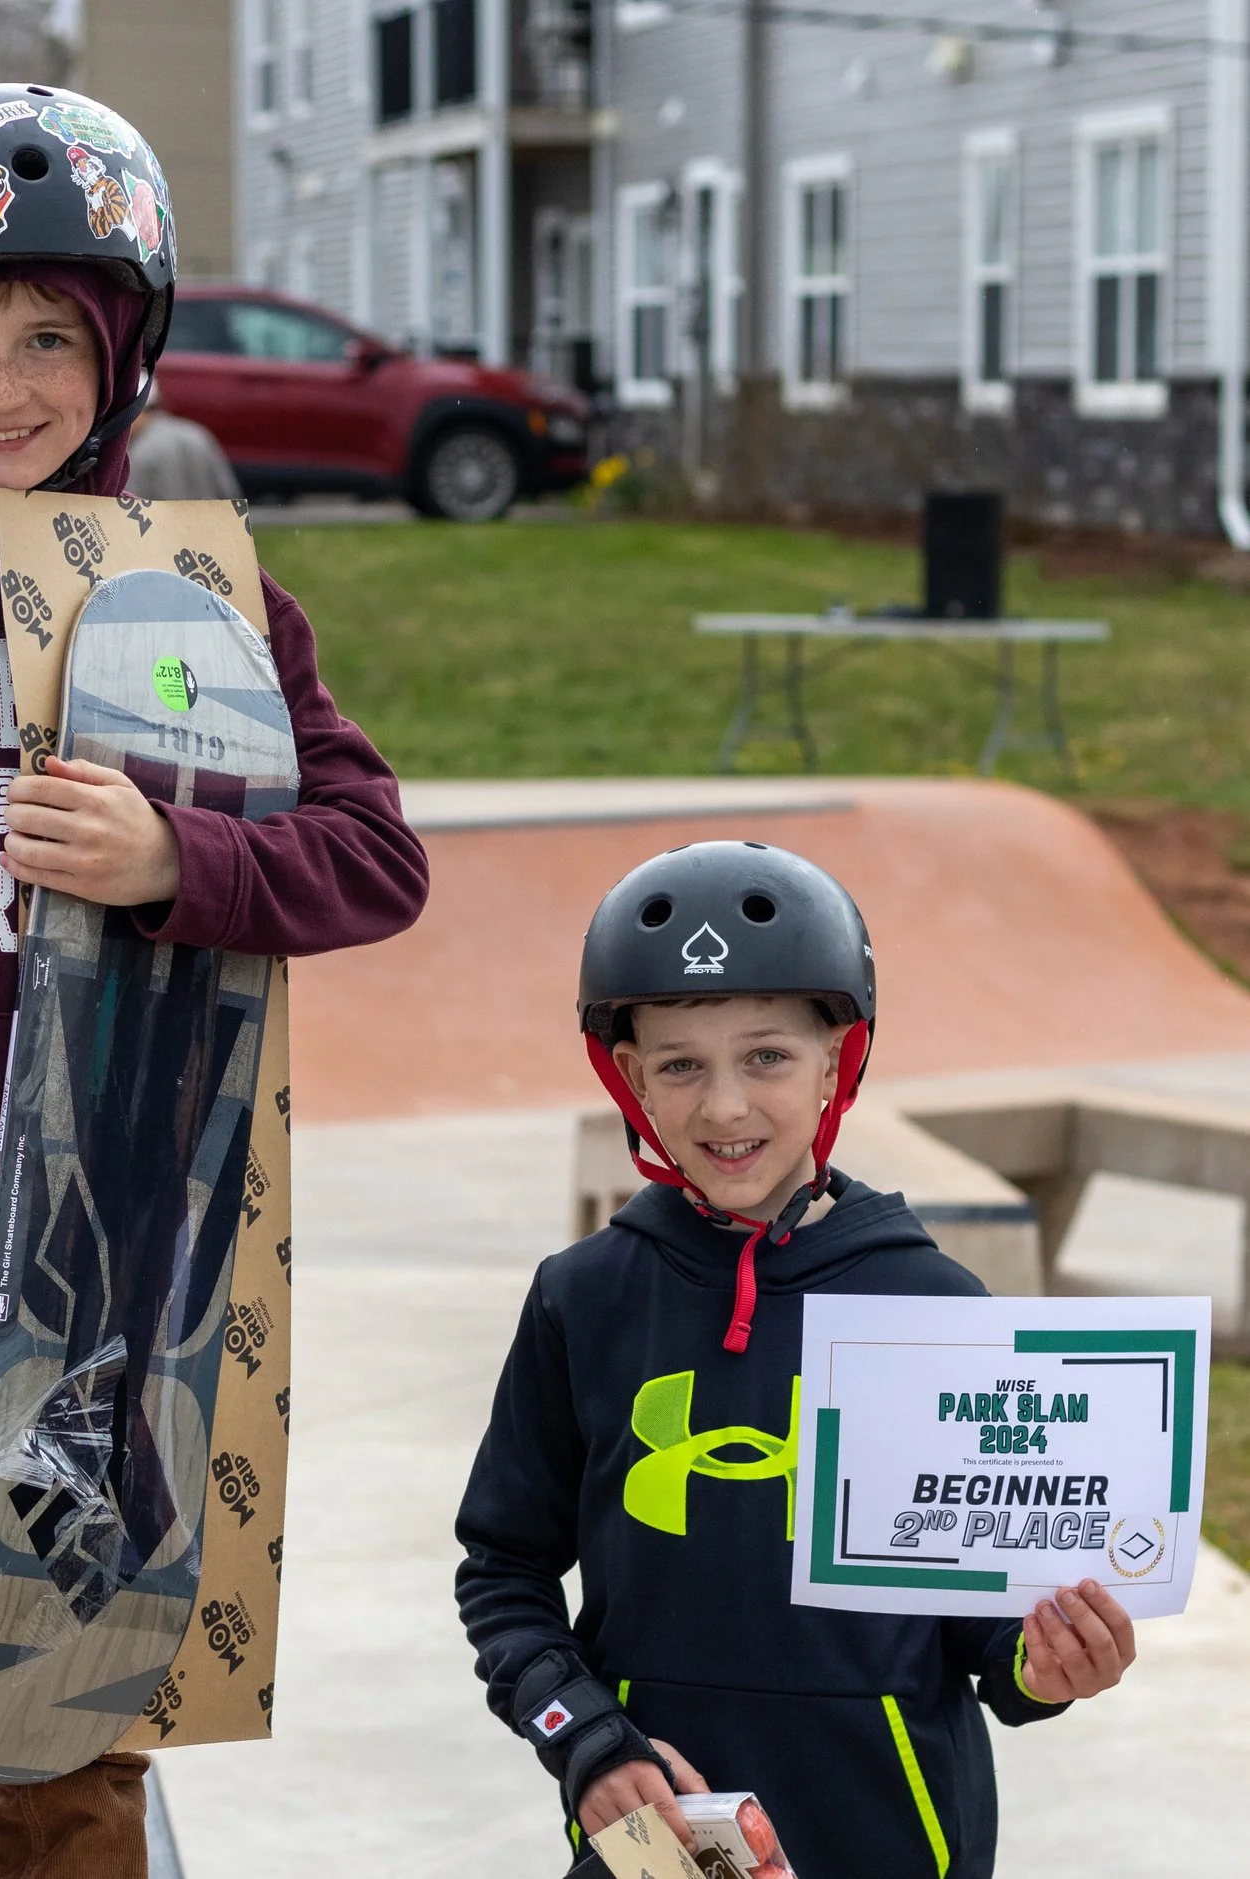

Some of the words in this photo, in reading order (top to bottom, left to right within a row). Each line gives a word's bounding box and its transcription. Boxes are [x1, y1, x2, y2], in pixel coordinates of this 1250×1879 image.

[74, 518, 103, 564] GRIP
[197, 552, 233, 596] GRIP
[1, 569, 53, 651] MOB
[22, 575, 53, 621] GRIP
[17, 1134, 25, 1151] Inc.
[11, 1152, 25, 1195] Company
[246, 1156, 264, 1197] GRI
[4, 1197, 18, 1250] Skateboard
[0, 1270, 9, 1287] The
[3, 1252, 11, 1269] Girl
[238, 1304, 265, 1348] GRIP
[996, 1379, 1036, 1392] WISE
[939, 1392, 1009, 1422] PARK
[1017, 1393, 1088, 1422] SLAM
[979, 1424, 1048, 1454] 2024
[234, 1455, 261, 1498] GRIP
[962, 1457, 976, 1465] This
[978, 1458, 1012, 1466] certificate
[1020, 1458, 1055, 1466] presented
[212, 1452, 256, 1529] MOB
[912, 1473, 1109, 1507] BEGINNER
[890, 1509, 957, 1548] 2ND
[962, 1511, 1110, 1550] PLACE
[201, 1600, 245, 1676] MOB
[224, 1603, 250, 1645] GRIP
[160, 1671, 182, 1710] GRI
